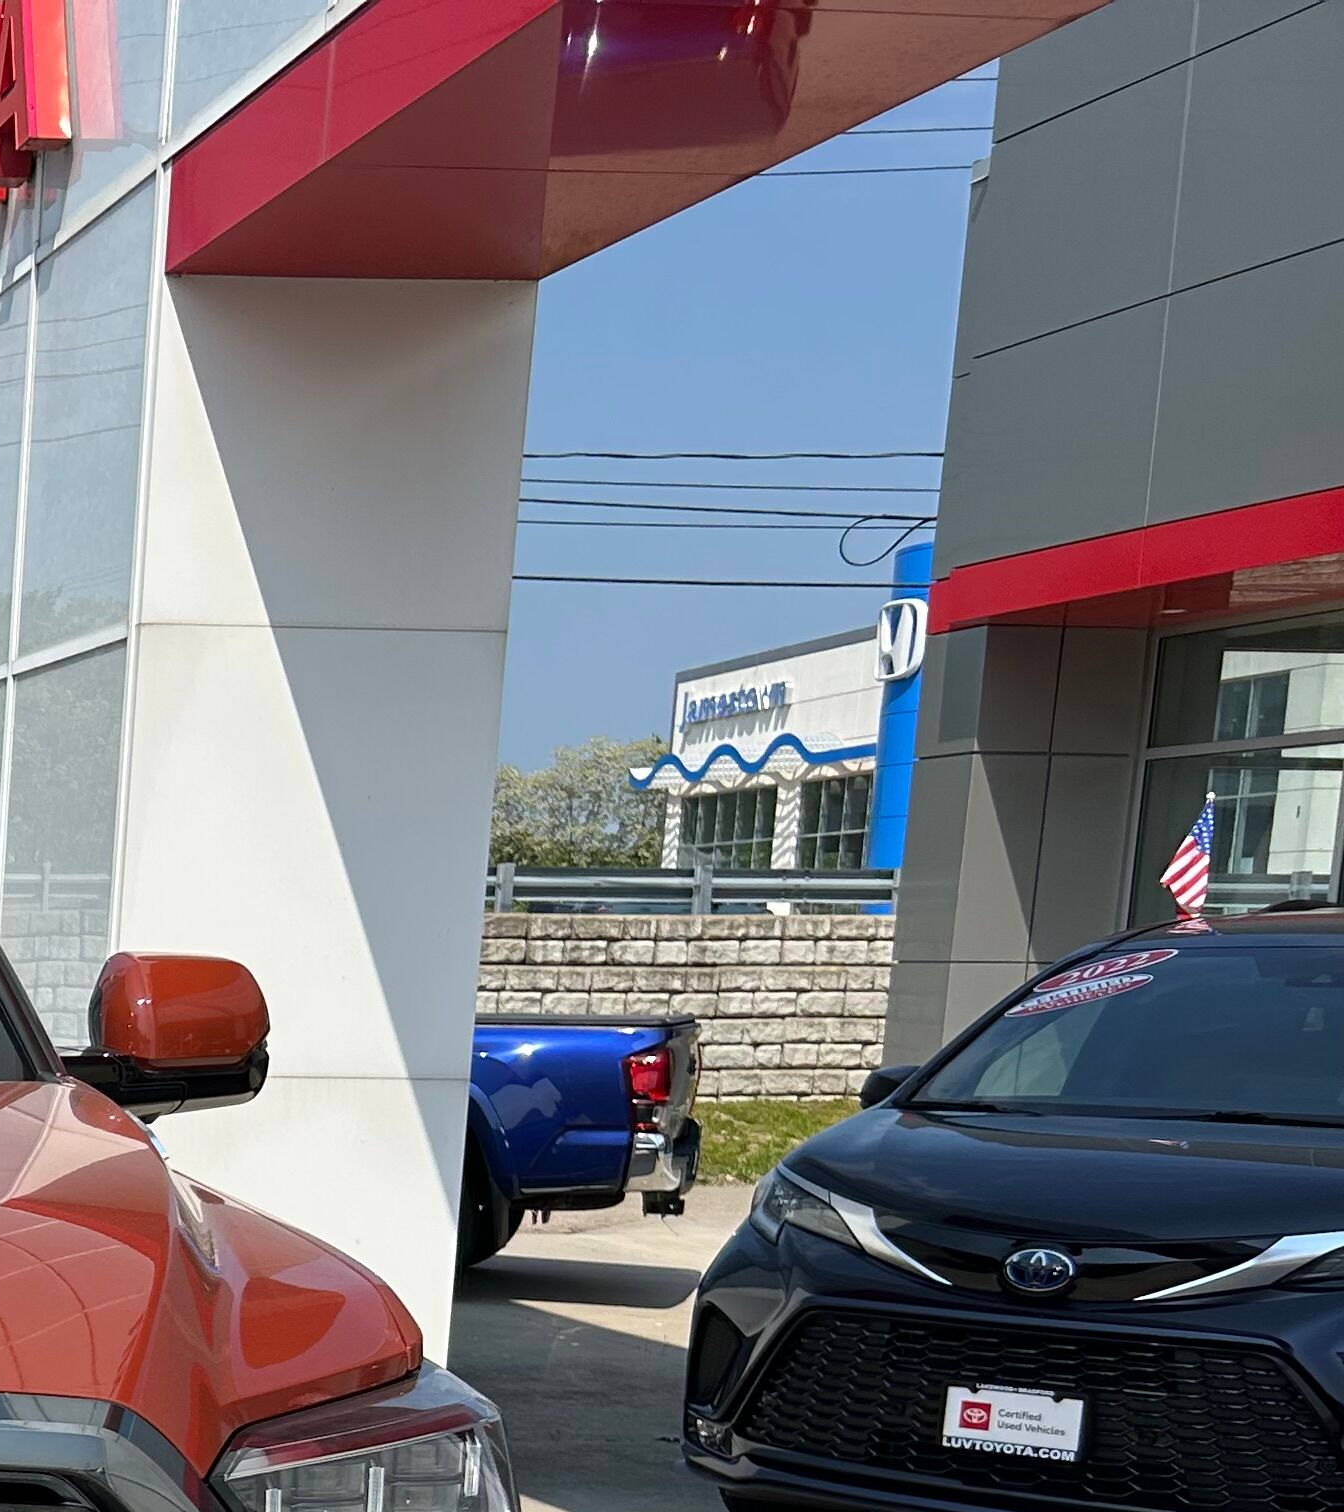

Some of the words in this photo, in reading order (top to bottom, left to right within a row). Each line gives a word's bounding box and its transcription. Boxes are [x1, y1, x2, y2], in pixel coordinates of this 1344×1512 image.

[1059, 952, 1151, 986] 2022
[998, 1408, 1042, 1421] Certified
[997, 1420, 1022, 1431] Used
[1024, 1423, 1066, 1436] Vehicles
[942, 1436, 1076, 1462] LUVTOYOTA.COM
